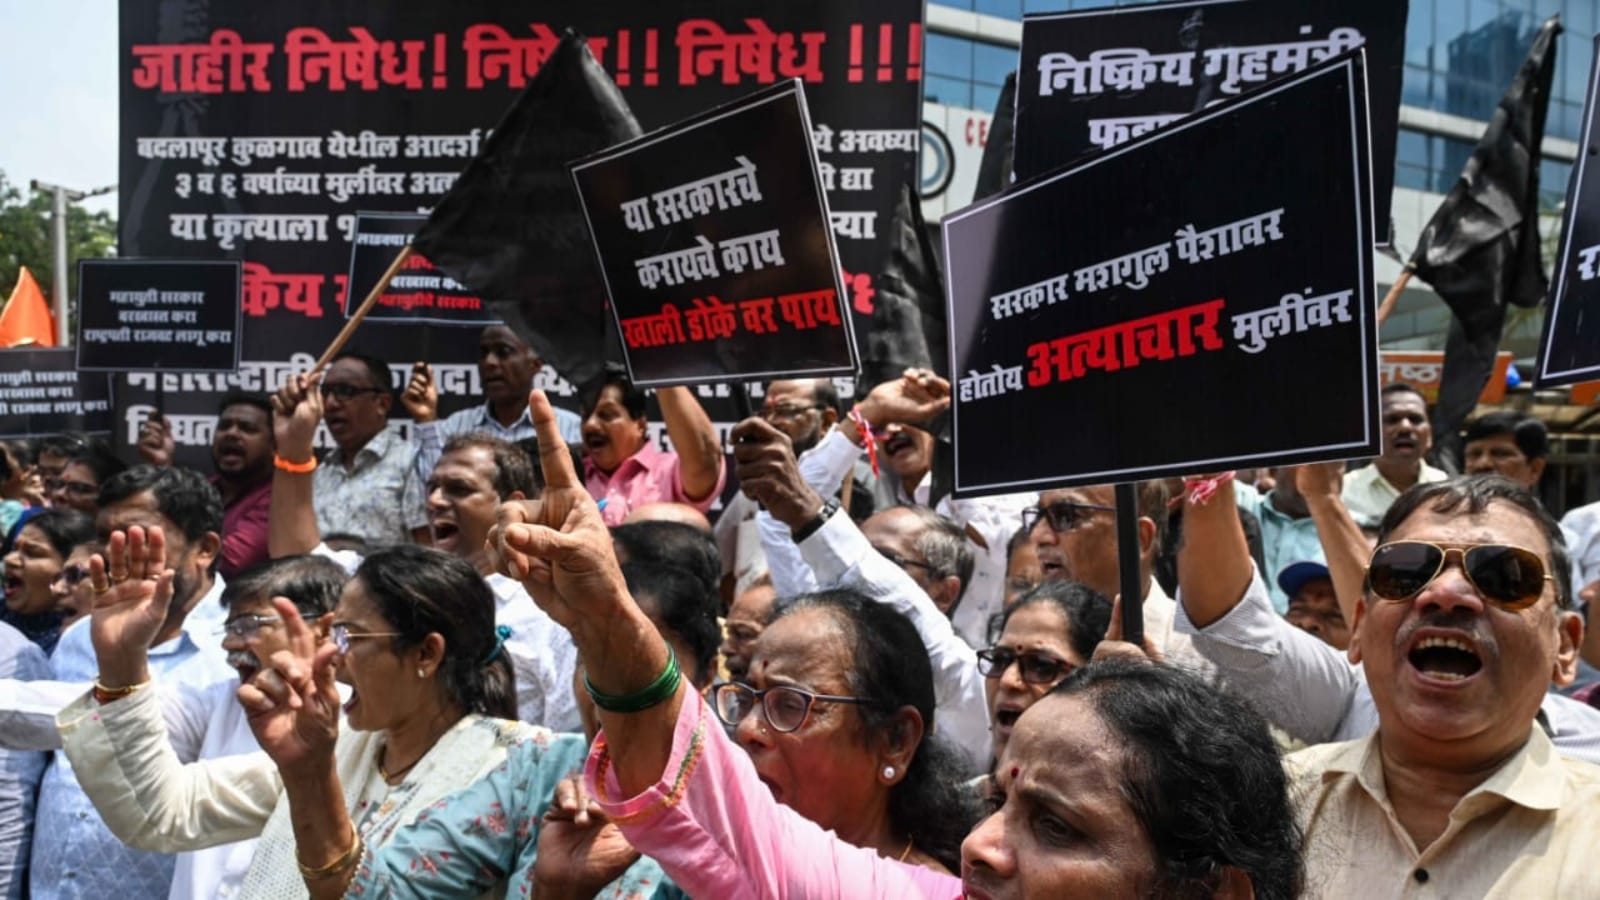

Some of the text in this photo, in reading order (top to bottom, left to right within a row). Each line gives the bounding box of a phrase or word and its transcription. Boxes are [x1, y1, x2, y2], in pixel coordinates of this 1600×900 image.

[131, 28, 275, 95] जाहीर
[1038, 47, 1196, 96] निष्क्रिय
[136, 136, 227, 166] बदलापूर
[232, 136, 322, 165] कुळगाव
[327, 130, 399, 158] येथील
[175, 173, 192, 199] ३
[197, 173, 214, 195] व
[220, 173, 237, 200] ६
[242, 167, 321, 195] वर्षाच्या
[620, 197, 655, 233] या
[652, 154, 763, 226] सरकारचे
[170, 213, 208, 240] या
[212, 213, 329, 250] कृत्याला
[634, 229, 786, 290] करायचे काय
[989, 208, 1285, 320] सरकार मशगुल पैशावर
[620, 302, 687, 348] खाली
[684, 296, 738, 342] डोके
[740, 298, 778, 334] वर
[778, 288, 841, 330] पाय
[959, 286, 1354, 403] होतोय अत्याचार मुलींवर
